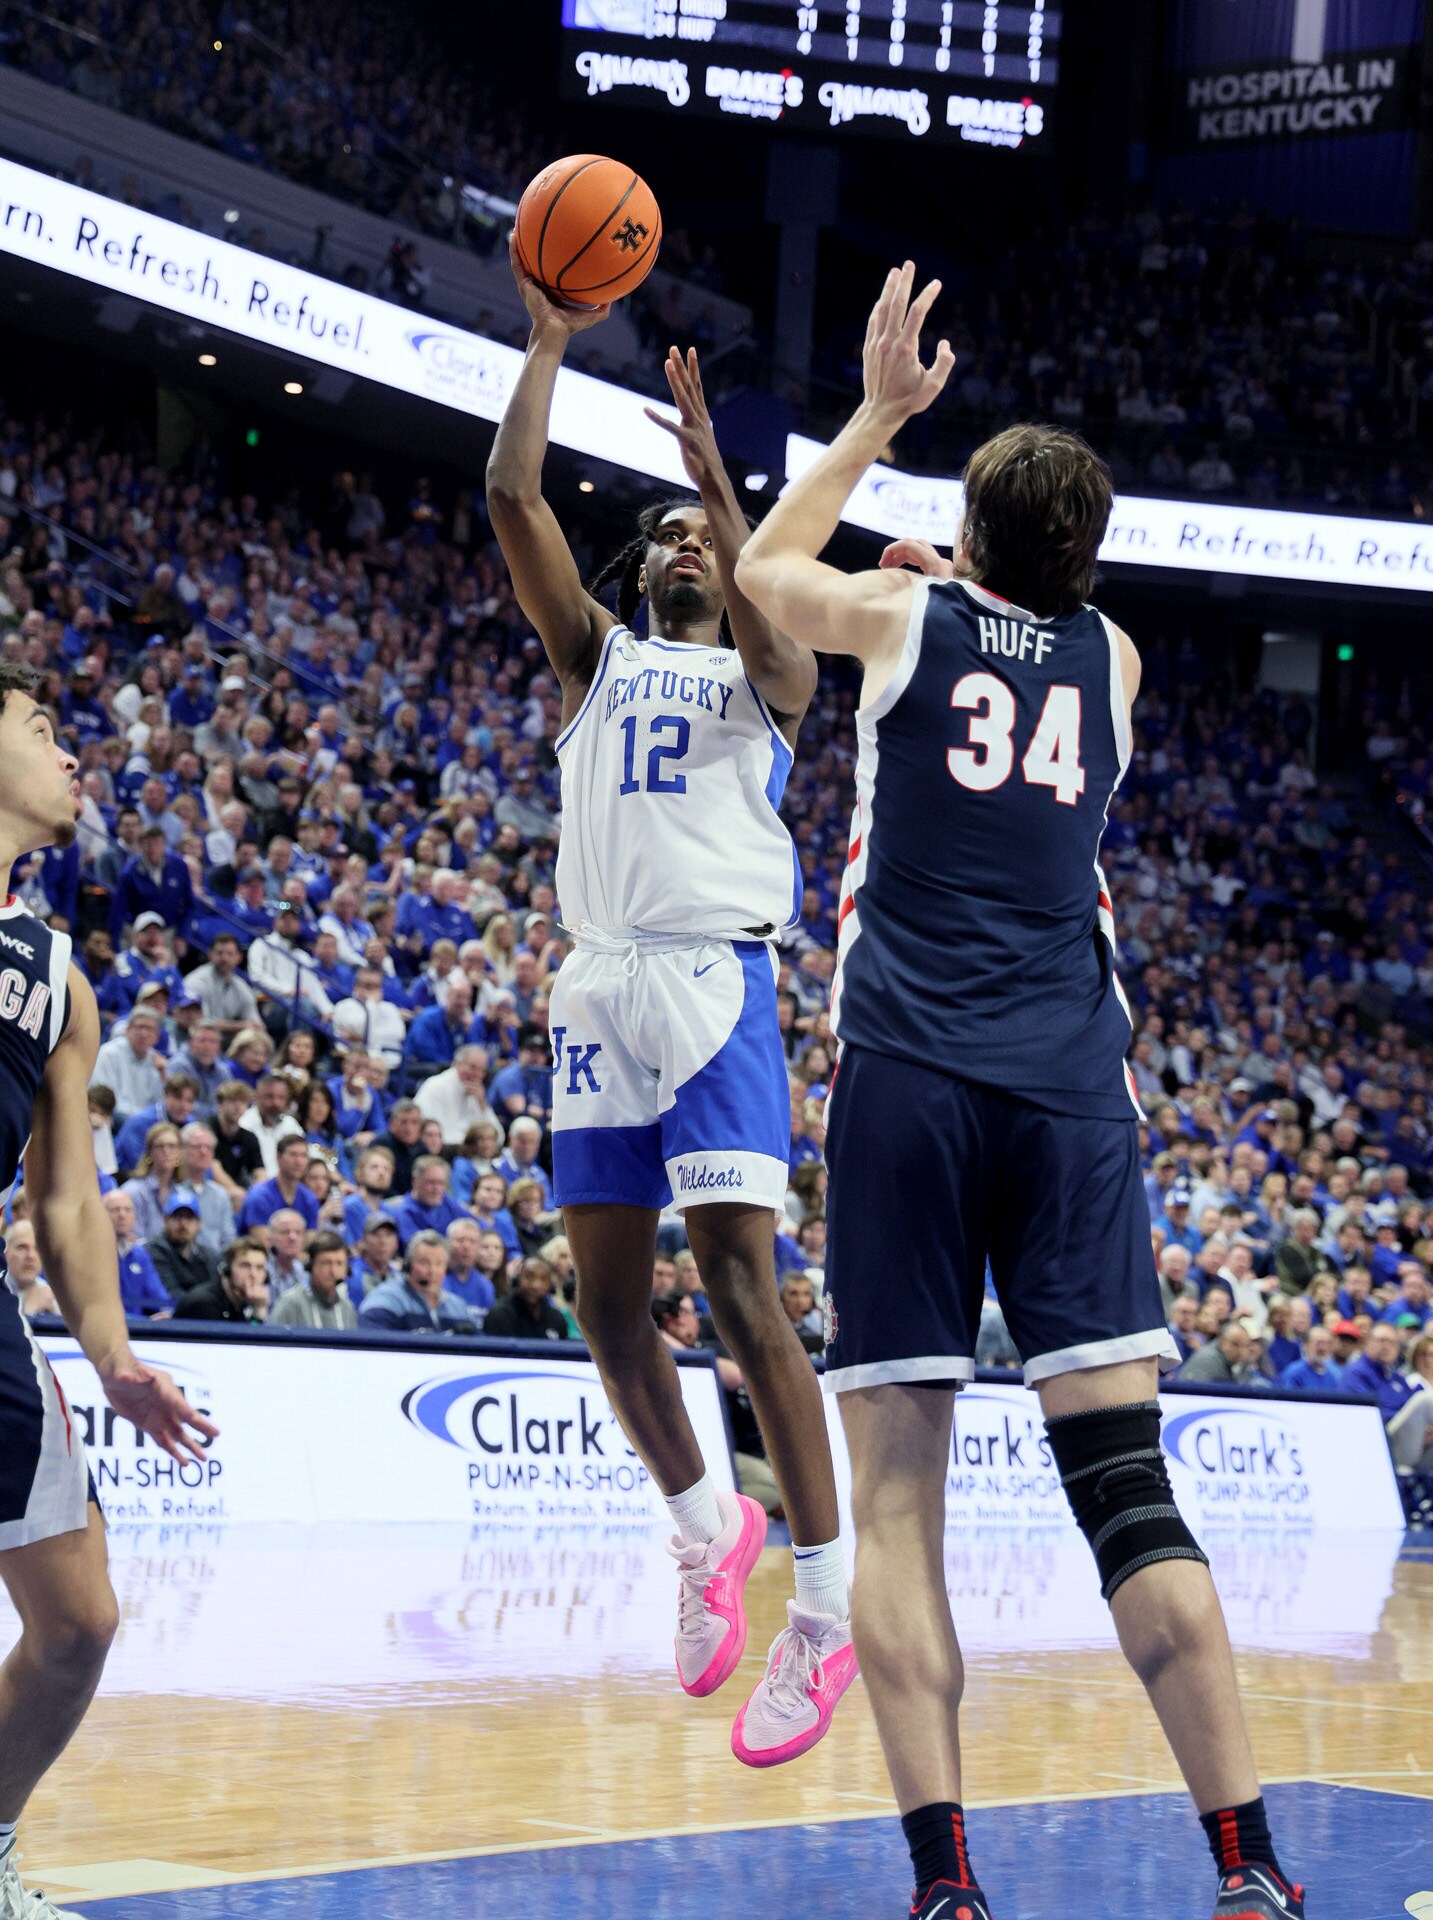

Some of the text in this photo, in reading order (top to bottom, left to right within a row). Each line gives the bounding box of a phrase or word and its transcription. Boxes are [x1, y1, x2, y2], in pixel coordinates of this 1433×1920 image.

[1187, 58, 1396, 108] HOSPITAL IN
[1199, 94, 1382, 142] KENTUCKY
[76, 216, 229, 306] Refresh.
[248, 280, 371, 355] Refuel.
[1179, 522, 1335, 565] Refresh.
[978, 616, 1056, 665] HUFF
[604, 668, 734, 723] KENTUCKY
[620, 715, 691, 796] 12
[946, 671, 1086, 807] 34
[0, 968, 51, 1041] GA
[677, 1164, 744, 1192] Wildcats
[471, 1393, 637, 1456] Clark'
[1196, 1426, 1303, 1475] Clark's
[468, 1463, 649, 1492] PUMP-N-SHOP
